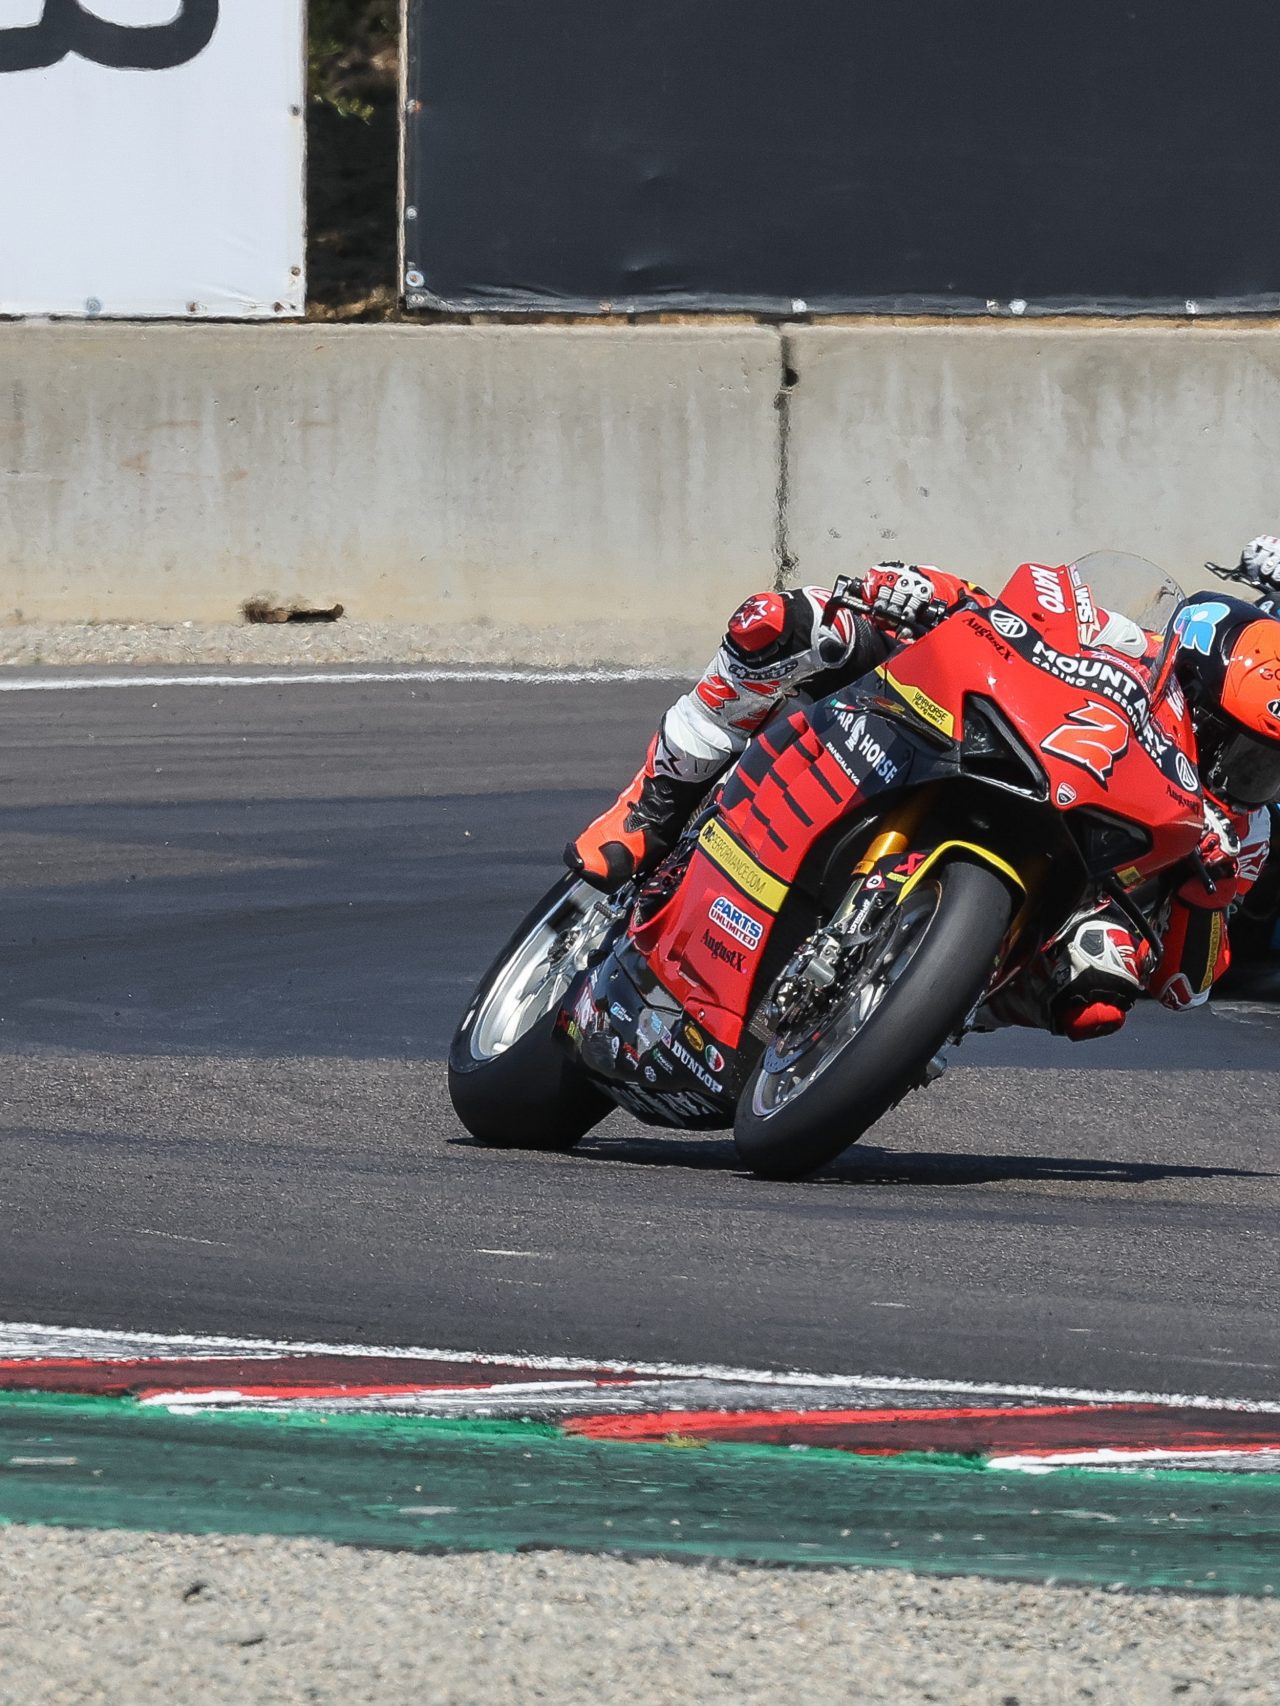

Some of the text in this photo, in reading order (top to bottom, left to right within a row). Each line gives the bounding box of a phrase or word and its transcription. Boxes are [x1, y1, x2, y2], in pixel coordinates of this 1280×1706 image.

[1029, 565, 1066, 614] KATO
[1033, 641, 1137, 696] MOUNT
[914, 691, 949, 722] WARHORSE
[1032, 657, 1086, 686] CASINO
[1103, 687, 1140, 732] RESORT
[826, 741, 853, 780] PANIGALE
[832, 708, 898, 785] AR HORSE
[1040, 699, 1129, 785] 2
[710, 909, 756, 947] UNLIMITED
[713, 898, 761, 938] PARTS
[701, 929, 747, 973] AugustX
[671, 1040, 723, 1093] DUNLOP
